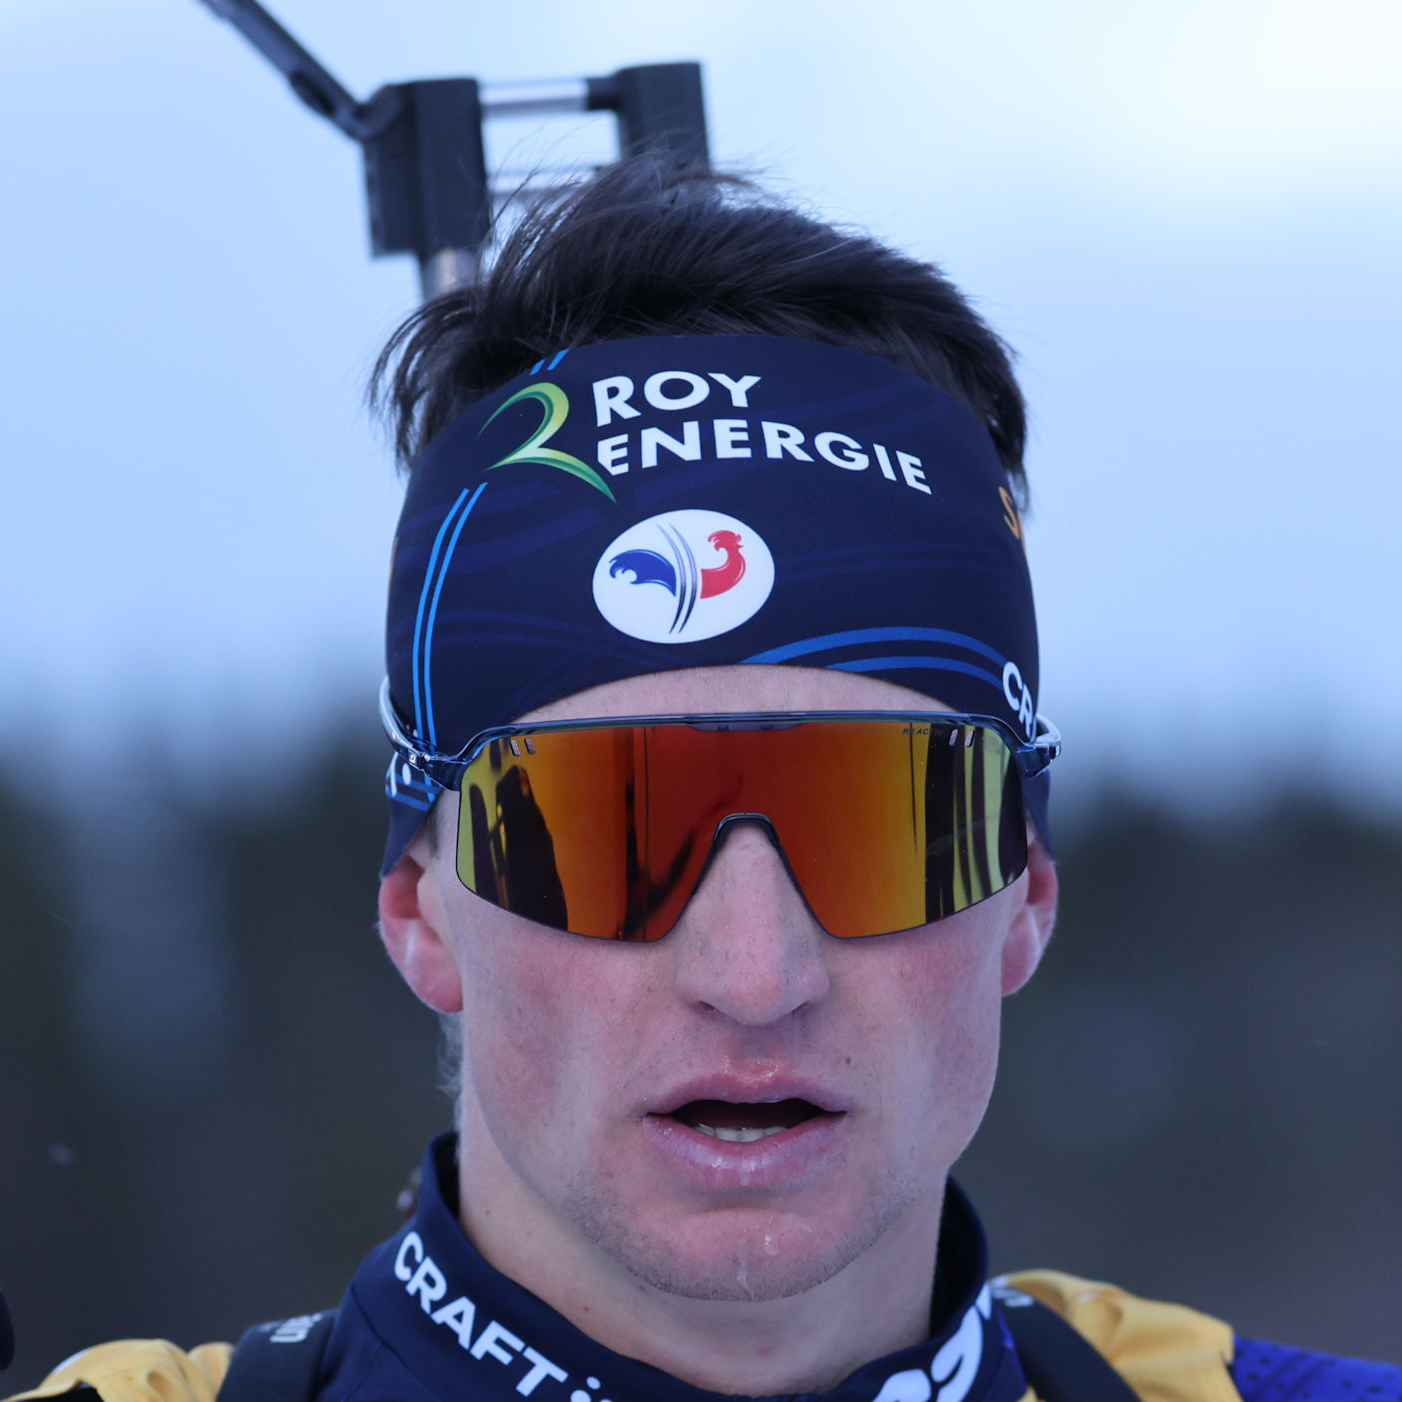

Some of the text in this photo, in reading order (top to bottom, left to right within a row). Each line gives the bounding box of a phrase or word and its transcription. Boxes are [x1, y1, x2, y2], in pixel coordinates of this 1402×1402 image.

[592, 370, 762, 428] ROY
[597, 418, 933, 496] ENERGIE
[1002, 661, 1037, 740] CR
[394, 1231, 570, 1398] CRAFT
